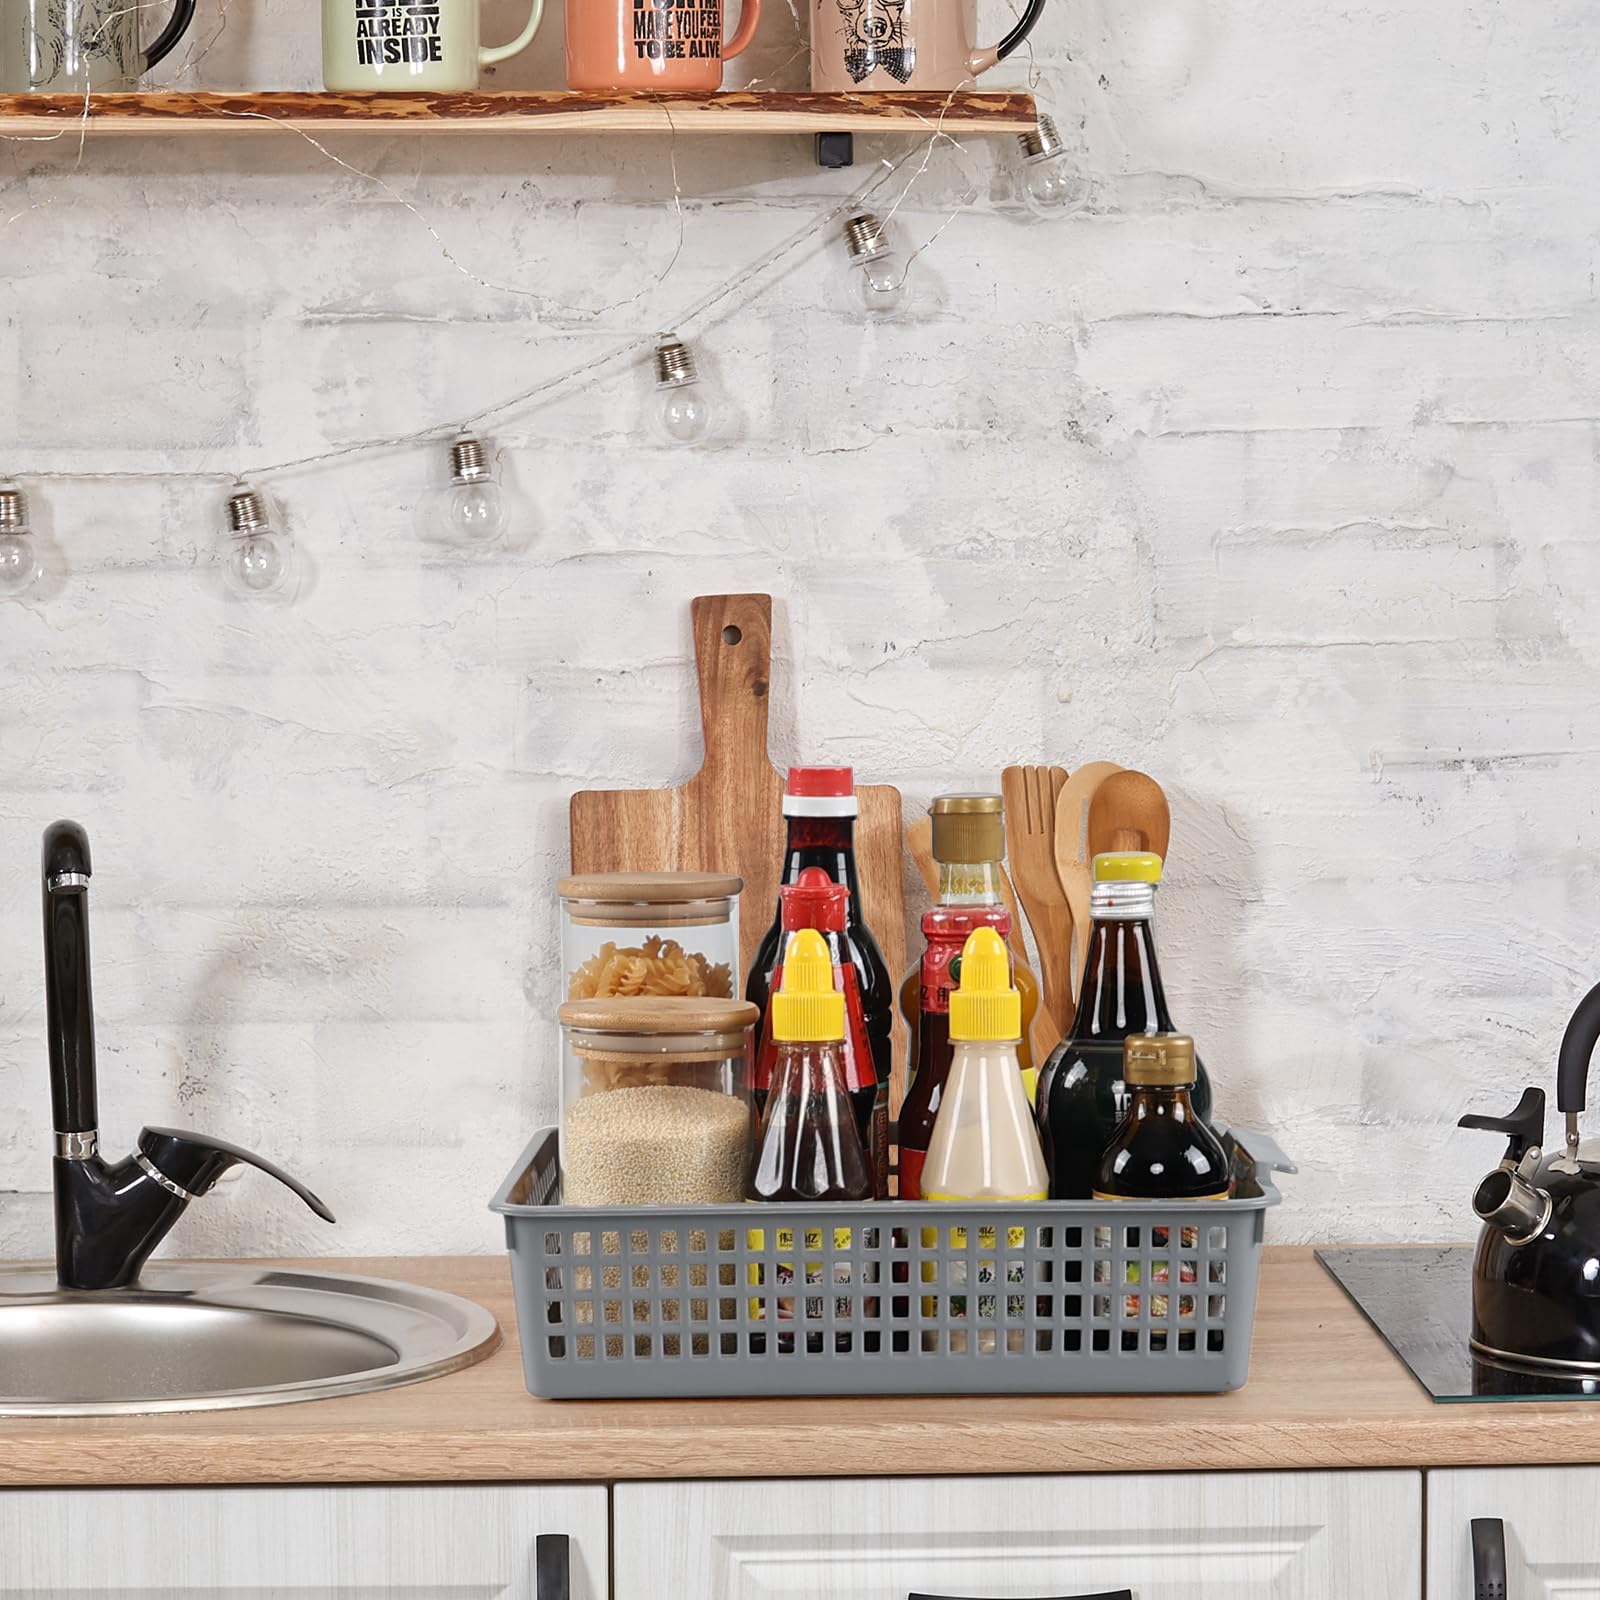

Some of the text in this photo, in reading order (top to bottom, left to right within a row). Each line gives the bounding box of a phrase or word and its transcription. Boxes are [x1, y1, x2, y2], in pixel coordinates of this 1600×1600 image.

[392, 8, 402, 17] IS
[700, 10, 720, 26] FEEL
[357, 16, 440, 37] ALREADY
[634, 10, 699, 39] MAKE YOU
[357, 36, 442, 64] INSIDE
[634, 40, 720, 59] TO BE ALIVE
